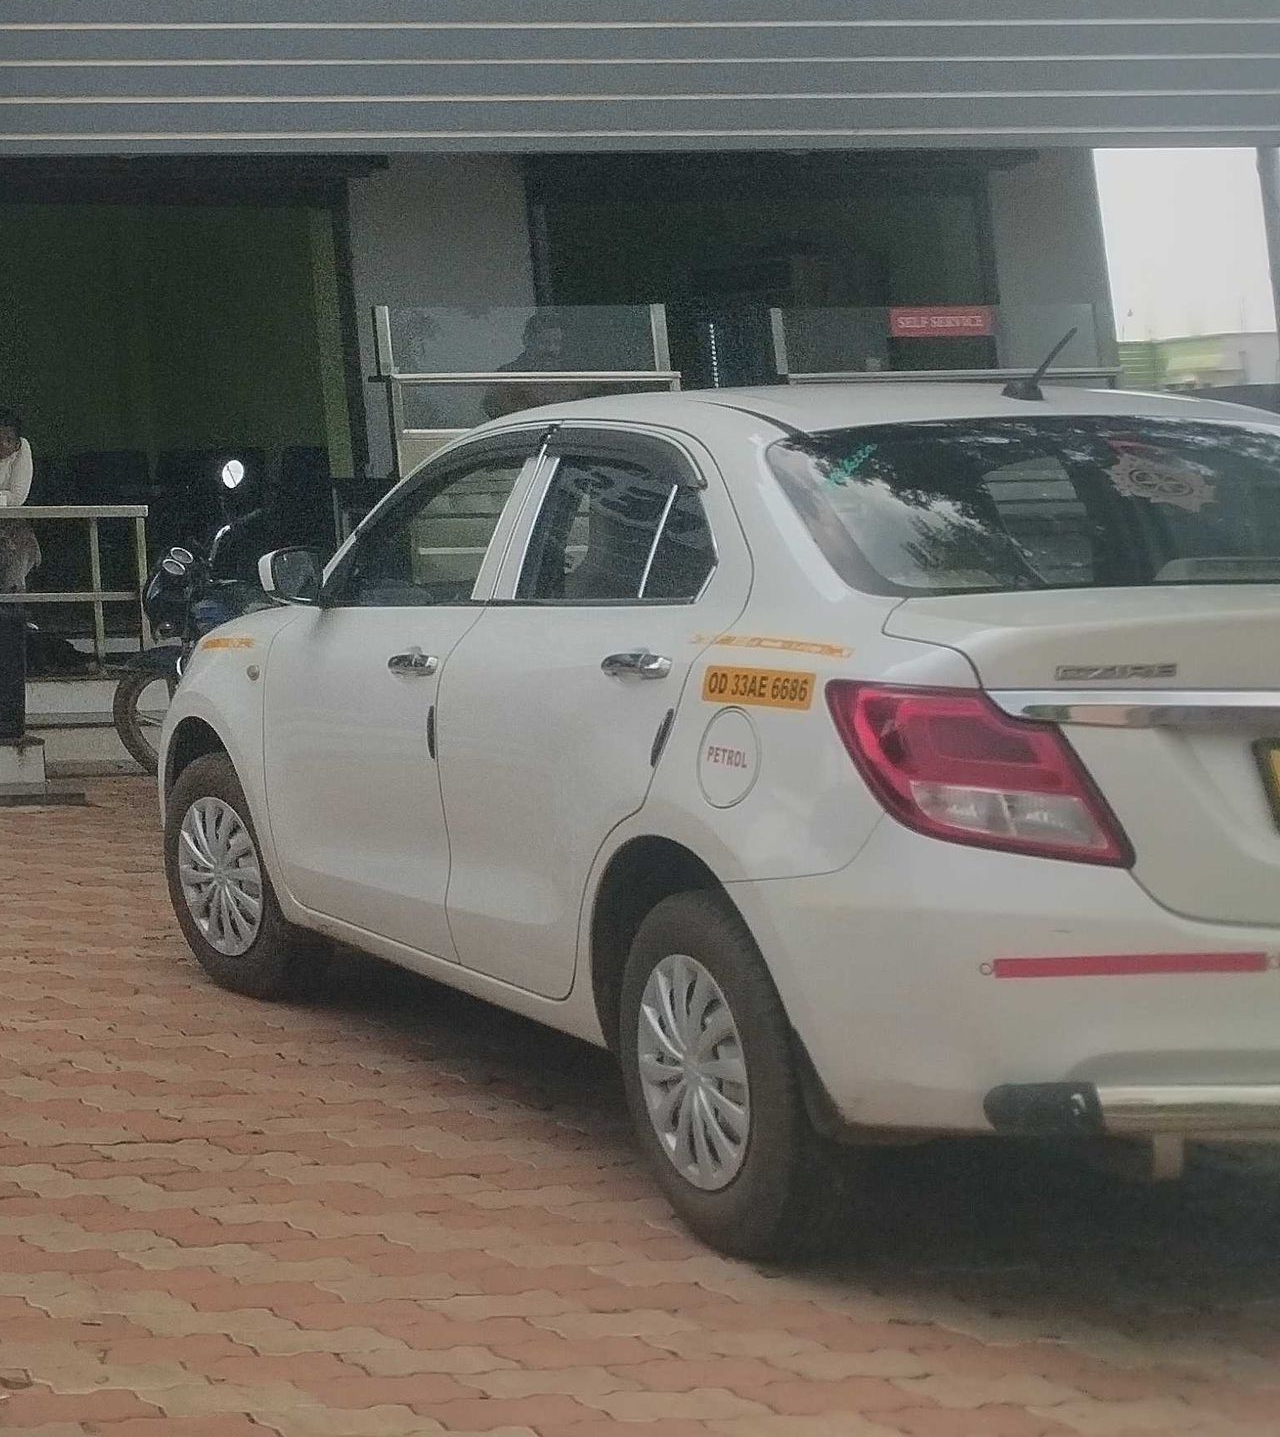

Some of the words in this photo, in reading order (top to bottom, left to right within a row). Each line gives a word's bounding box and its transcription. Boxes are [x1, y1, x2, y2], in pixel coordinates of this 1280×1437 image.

[708, 672, 729, 694] OD
[731, 674, 768, 698] 33AE
[707, 746, 748, 768] PETROL
